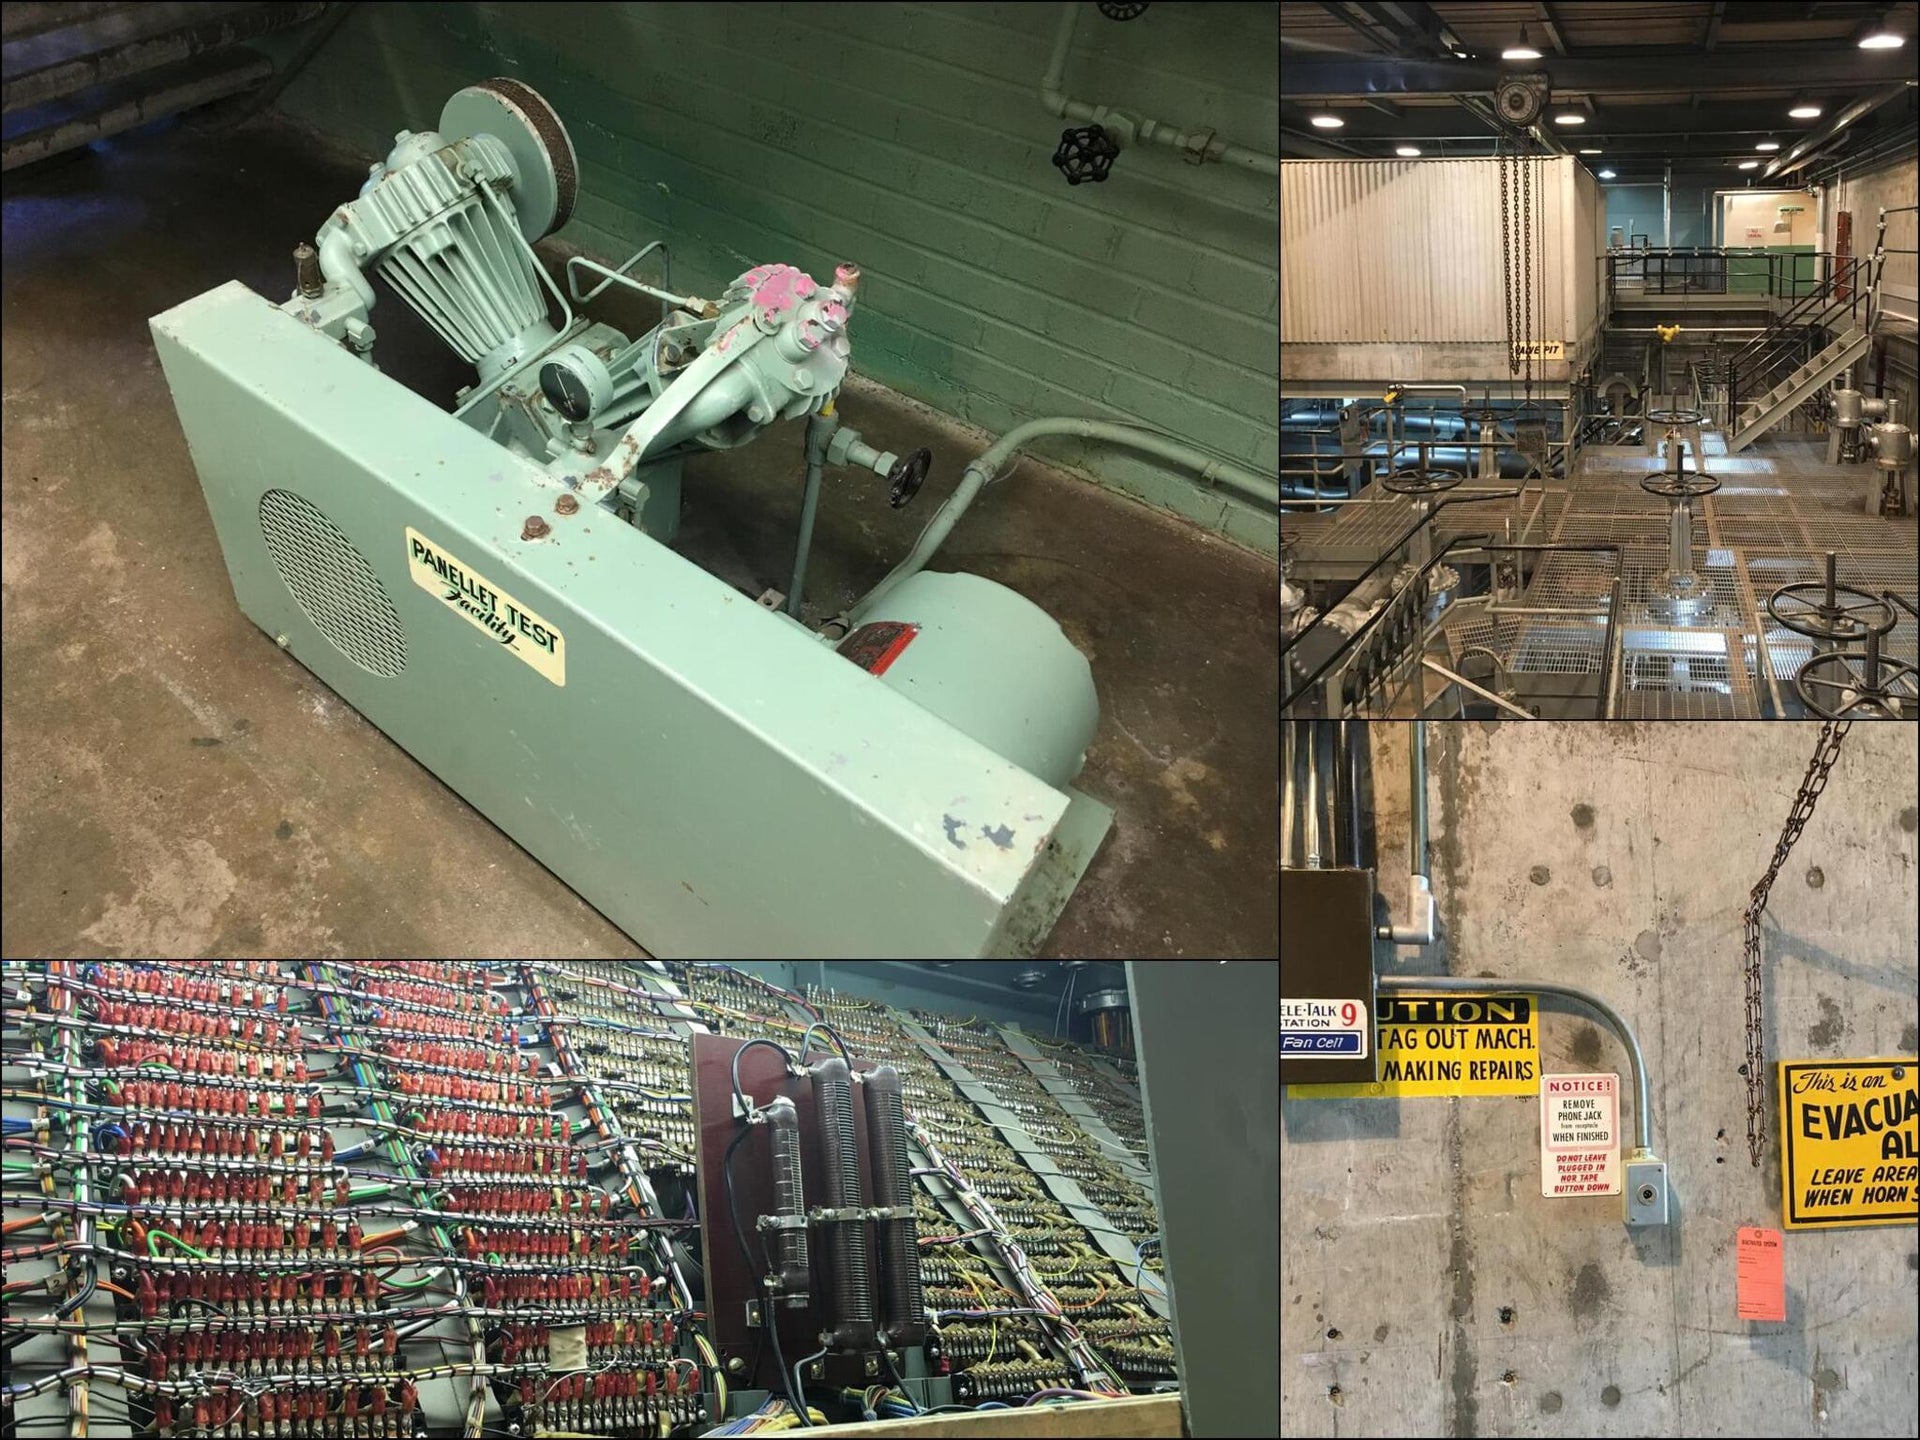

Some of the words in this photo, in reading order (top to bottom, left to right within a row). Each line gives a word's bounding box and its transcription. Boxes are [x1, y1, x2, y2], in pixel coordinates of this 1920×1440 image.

[1515, 346, 1540, 354] AVE
[1543, 346, 1559, 354] PIT
[412, 538, 498, 612] PANELLET
[506, 604, 558, 653] TEST
[442, 581, 518, 647] Facility
[1341, 1003, 1357, 1026] 9
[1281, 1018, 1330, 1027] TATION
[1283, 1037, 1313, 1049] Fan
[1316, 1037, 1344, 1048] Cell
[1378, 1028, 1417, 1049] TAG
[1426, 1028, 1468, 1050] OUT
[1475, 1028, 1535, 1049] MACH.
[1383, 1061, 1462, 1081] MAKING
[1469, 1060, 1533, 1081] REPAIRS
[1550, 1082, 1611, 1092] NOTICE!
[1793, 1072, 1837, 1094] This
[1840, 1073, 1858, 1091] is
[1862, 1075, 1886, 1088] an
[1562, 1099, 1595, 1109] REMOVE
[1558, 1111, 1582, 1121] PHONE
[1583, 1111, 1602, 1120] JACK
[1552, 1132, 1574, 1142] WHEN
[1576, 1131, 1609, 1141] FINISHED
[1568, 1154, 1583, 1162] NOT
[1558, 1164, 1593, 1172] PLUGGED
[1596, 1163, 1606, 1171] IN
[1560, 1174, 1577, 1182] NOR
[1580, 1173, 1598, 1181] TAPE
[1811, 1168, 1865, 1186] LEAVE
[1554, 1184, 1584, 1192] BUTTON
[1587, 1183, 1610, 1191] DOWN
[1804, 1188, 1854, 1208] WHEN
[1862, 1186, 1908, 1204] HORN
